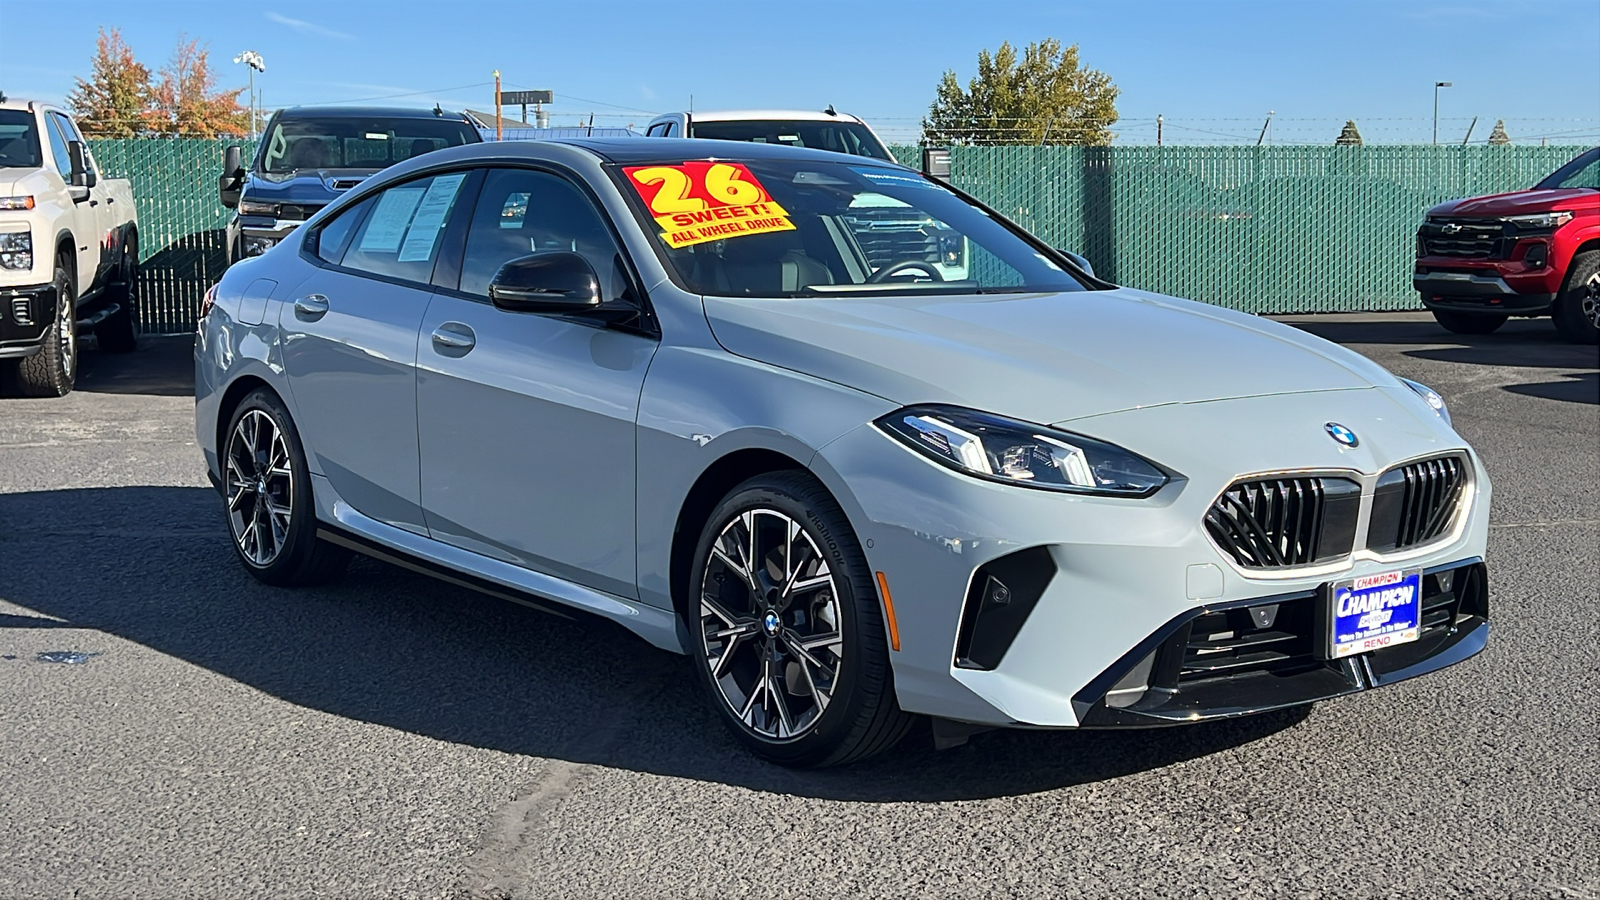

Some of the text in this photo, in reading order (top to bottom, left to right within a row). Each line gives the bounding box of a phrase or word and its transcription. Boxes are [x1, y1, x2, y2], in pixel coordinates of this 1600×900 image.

[632, 163, 766, 213] 26
[672, 203, 770, 227] SWEET!
[671, 217, 786, 244] ALL WHEEL DRIVE
[1356, 573, 1399, 589] CHAMPION
[1336, 585, 1415, 618] CHAMPION
[1361, 612, 1390, 625] CHEVROLET
[1363, 636, 1391, 649] RENO
